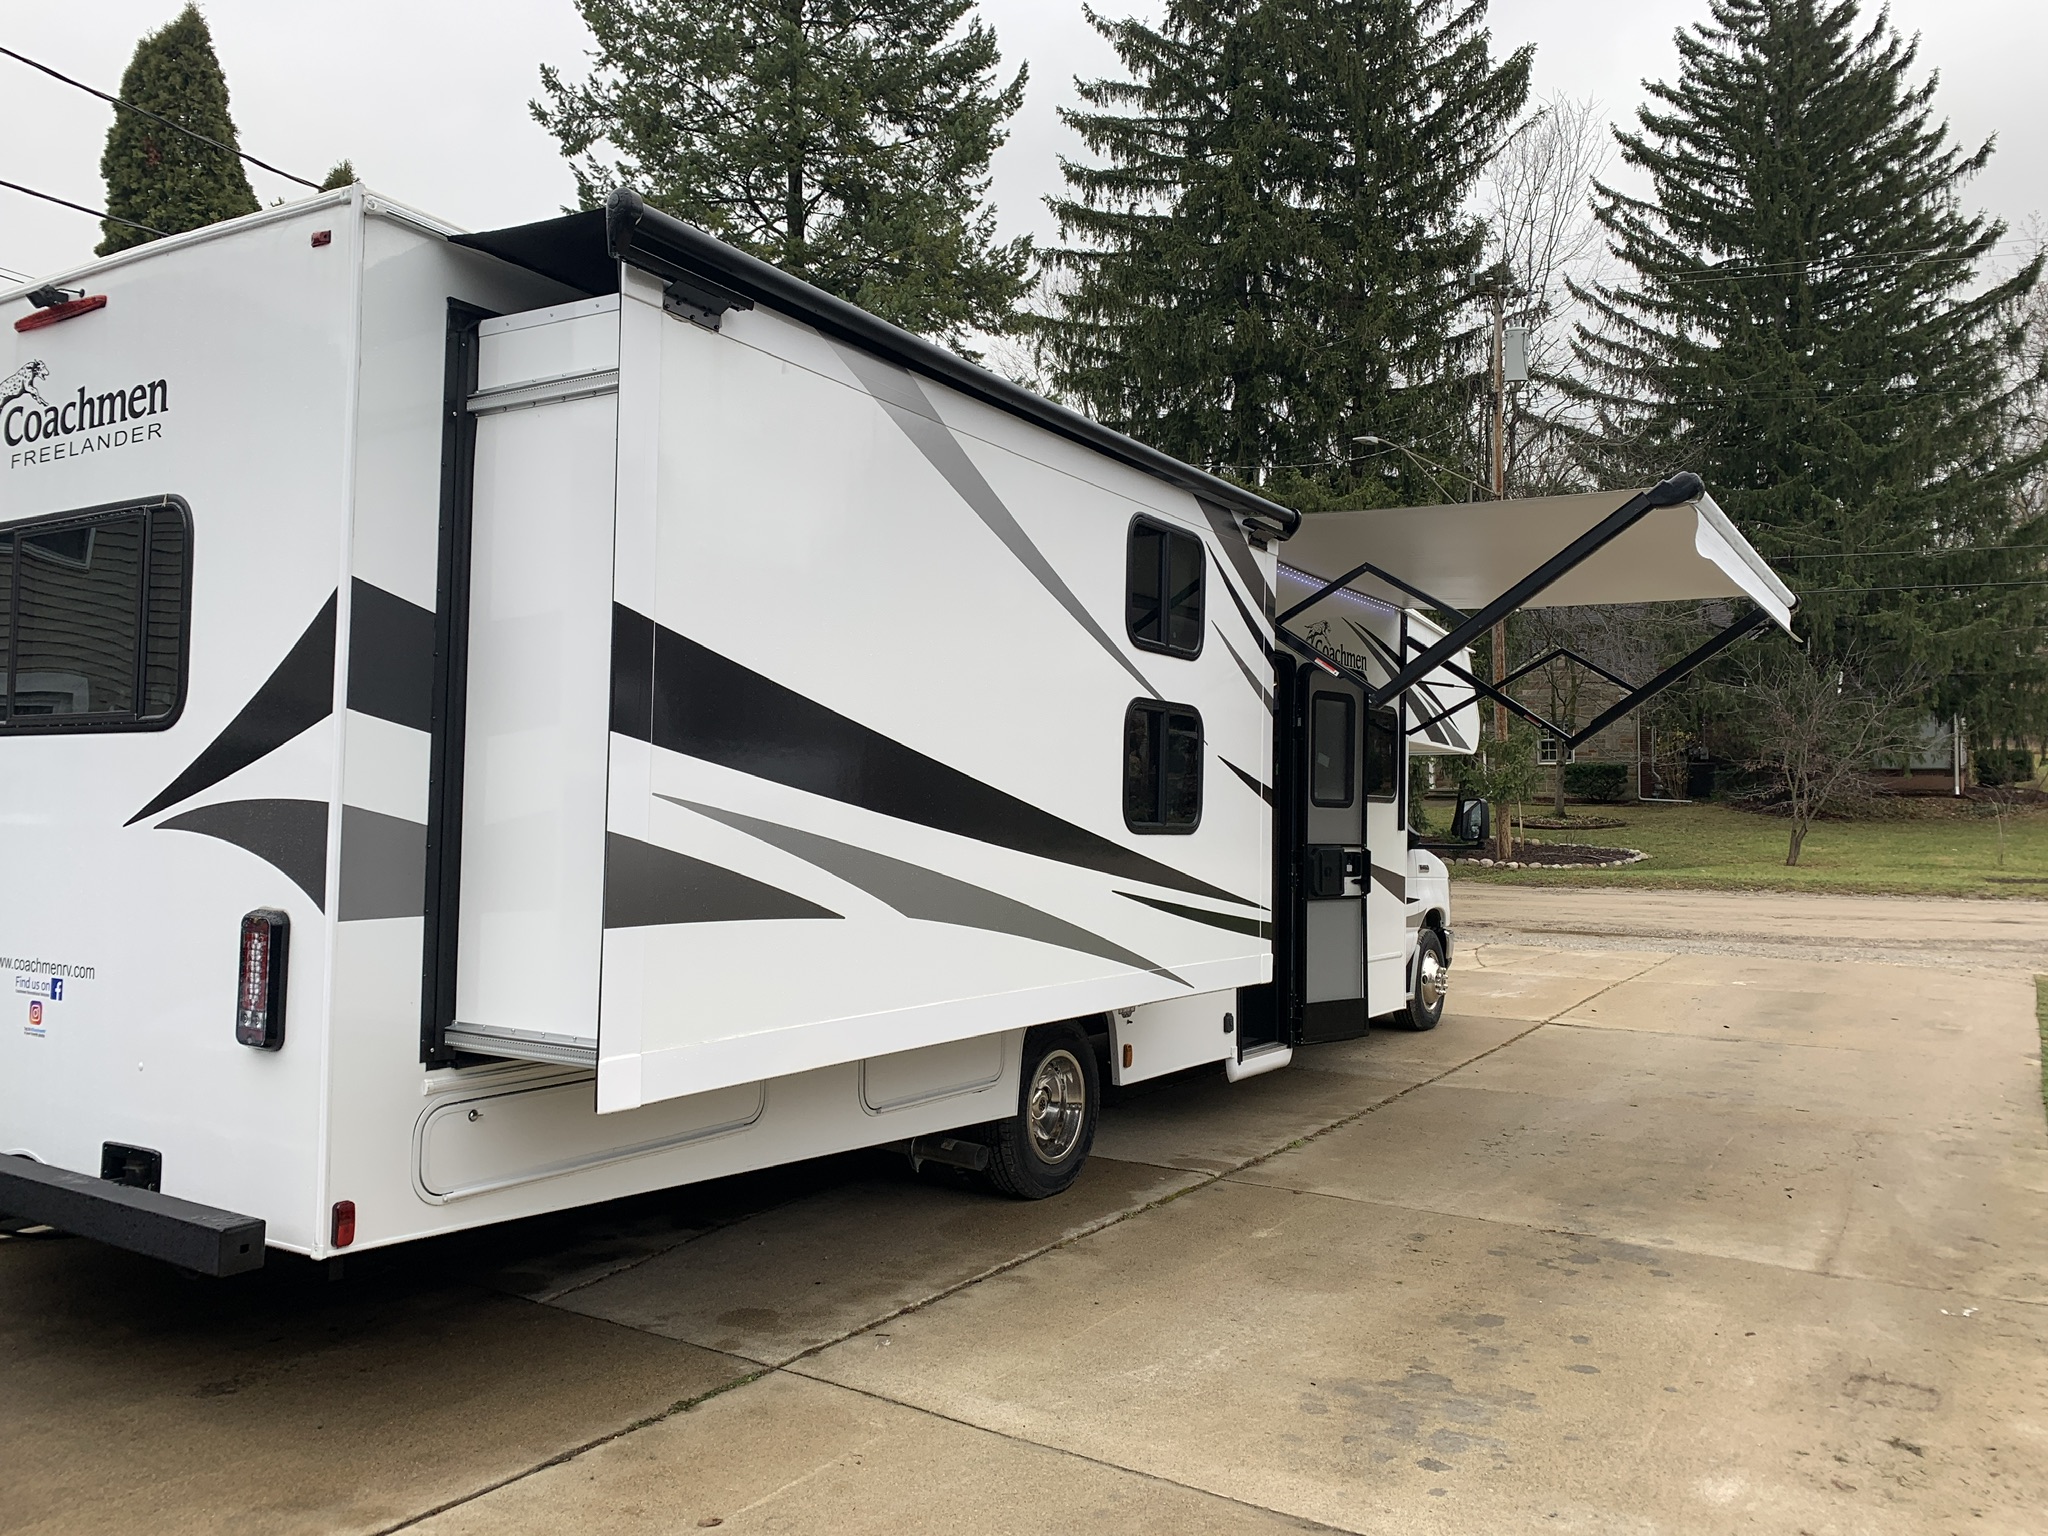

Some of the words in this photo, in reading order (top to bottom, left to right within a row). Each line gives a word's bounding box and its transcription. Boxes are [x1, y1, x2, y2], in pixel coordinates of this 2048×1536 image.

[4, 378, 169, 447] Coachmen
[11, 422, 162, 469] FREELANDER
[15, 975, 31, 989] Find
[31, 980, 40, 991] us
[41, 981, 50, 992] on
